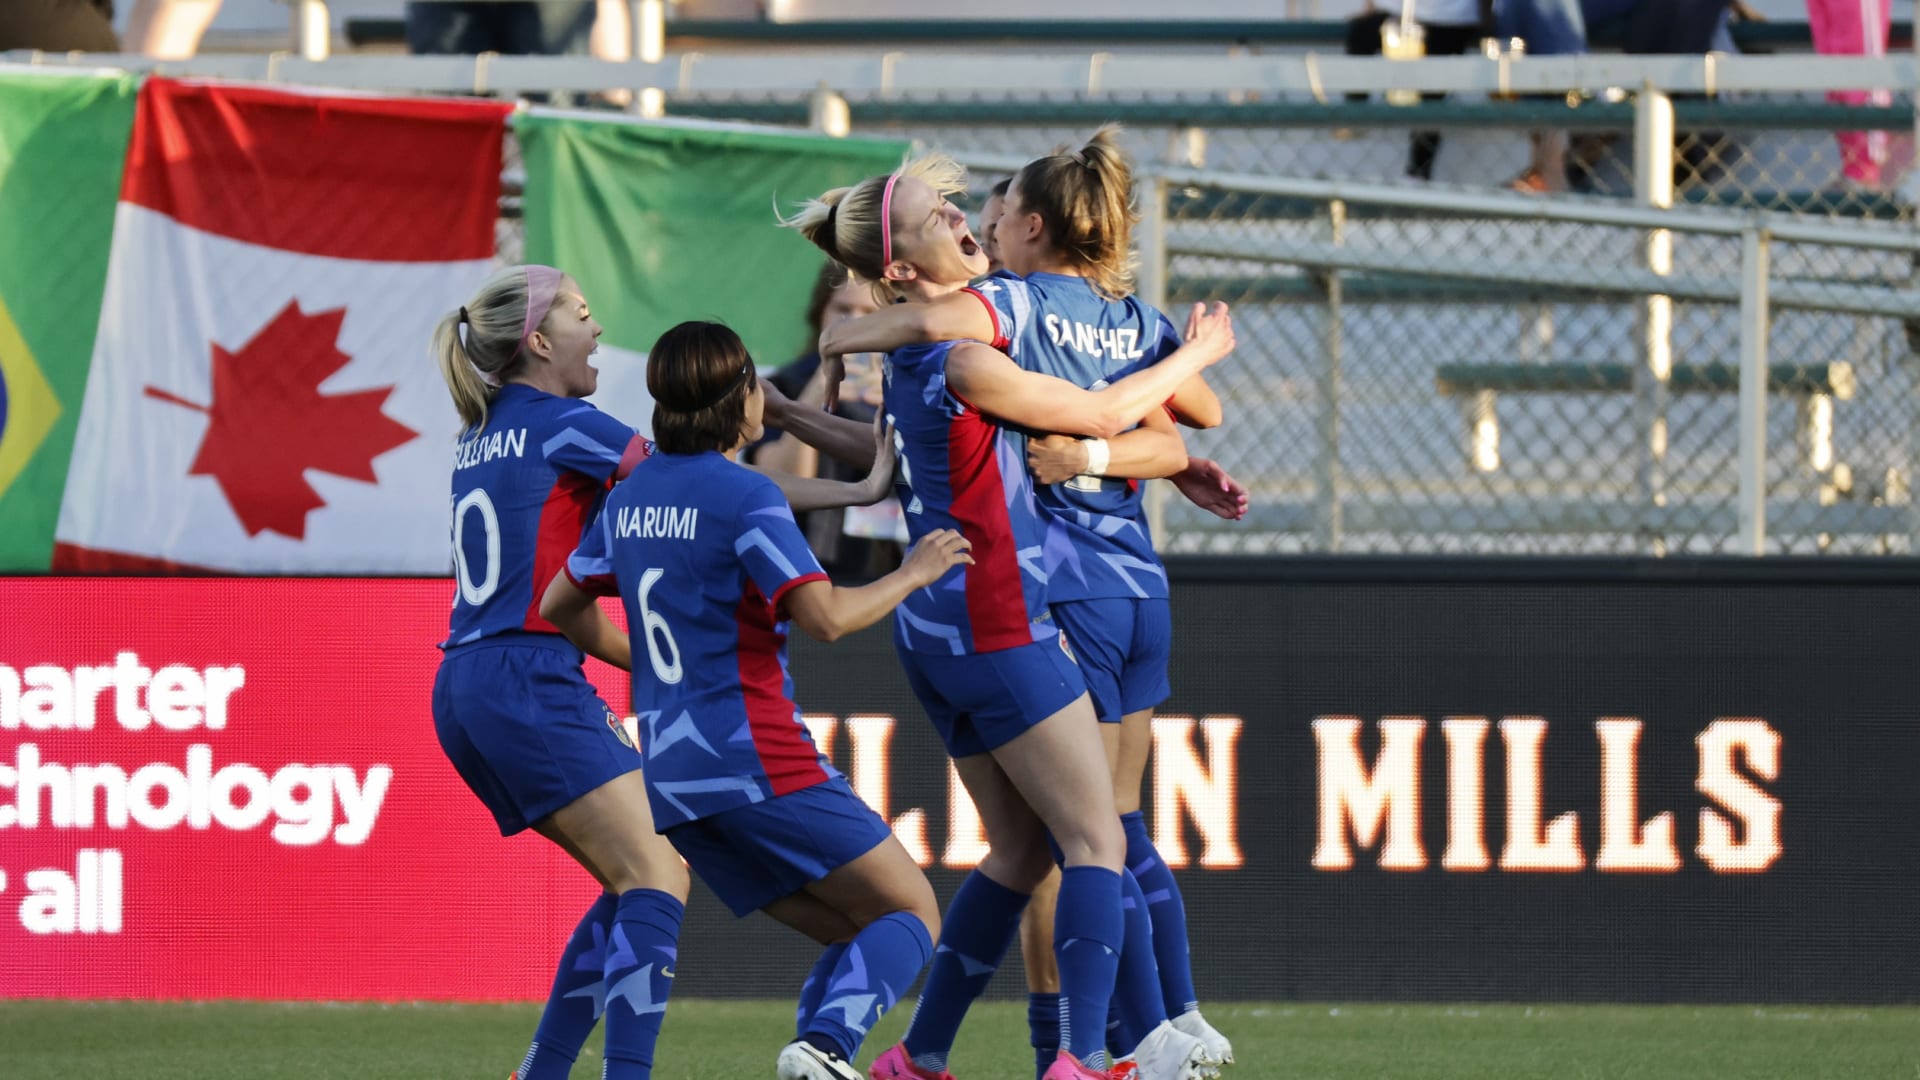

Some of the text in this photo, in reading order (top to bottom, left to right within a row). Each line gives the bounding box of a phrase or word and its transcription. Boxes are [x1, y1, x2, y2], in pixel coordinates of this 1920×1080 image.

[1045, 313, 1144, 361] SANCHEZ
[616, 506, 698, 540] NARUMI
[637, 567, 683, 685] 6
[0, 651, 245, 731] arter
[1311, 715, 1783, 872] MILLS
[19, 848, 122, 934] all
